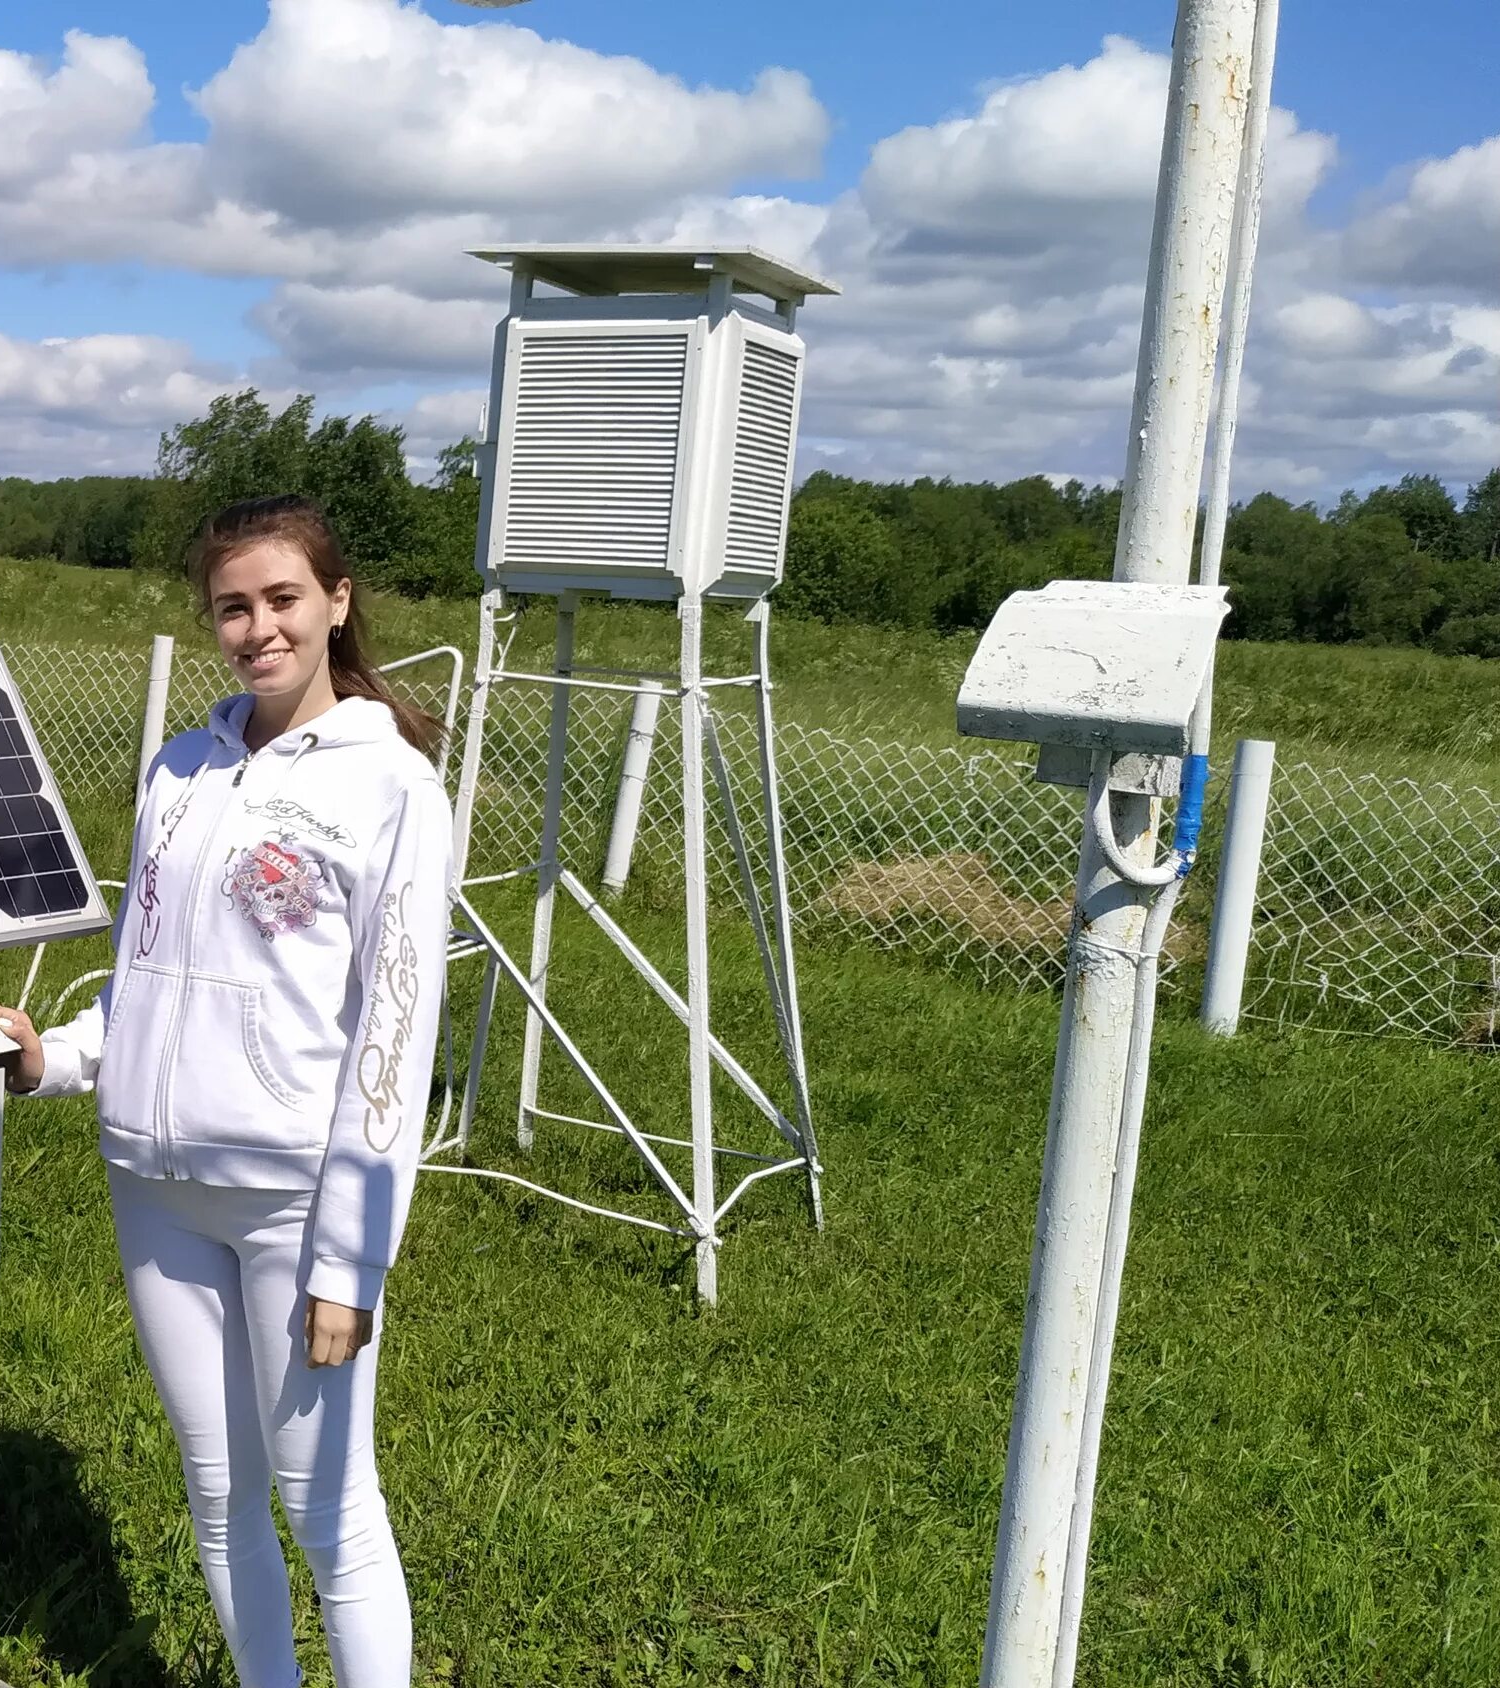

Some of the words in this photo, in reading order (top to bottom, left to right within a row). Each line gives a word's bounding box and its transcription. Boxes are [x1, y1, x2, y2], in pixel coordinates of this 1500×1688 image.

[274, 801, 357, 848] Hardy
[262, 851, 301, 880] KILLS
[357, 957, 419, 1154] Hardy
